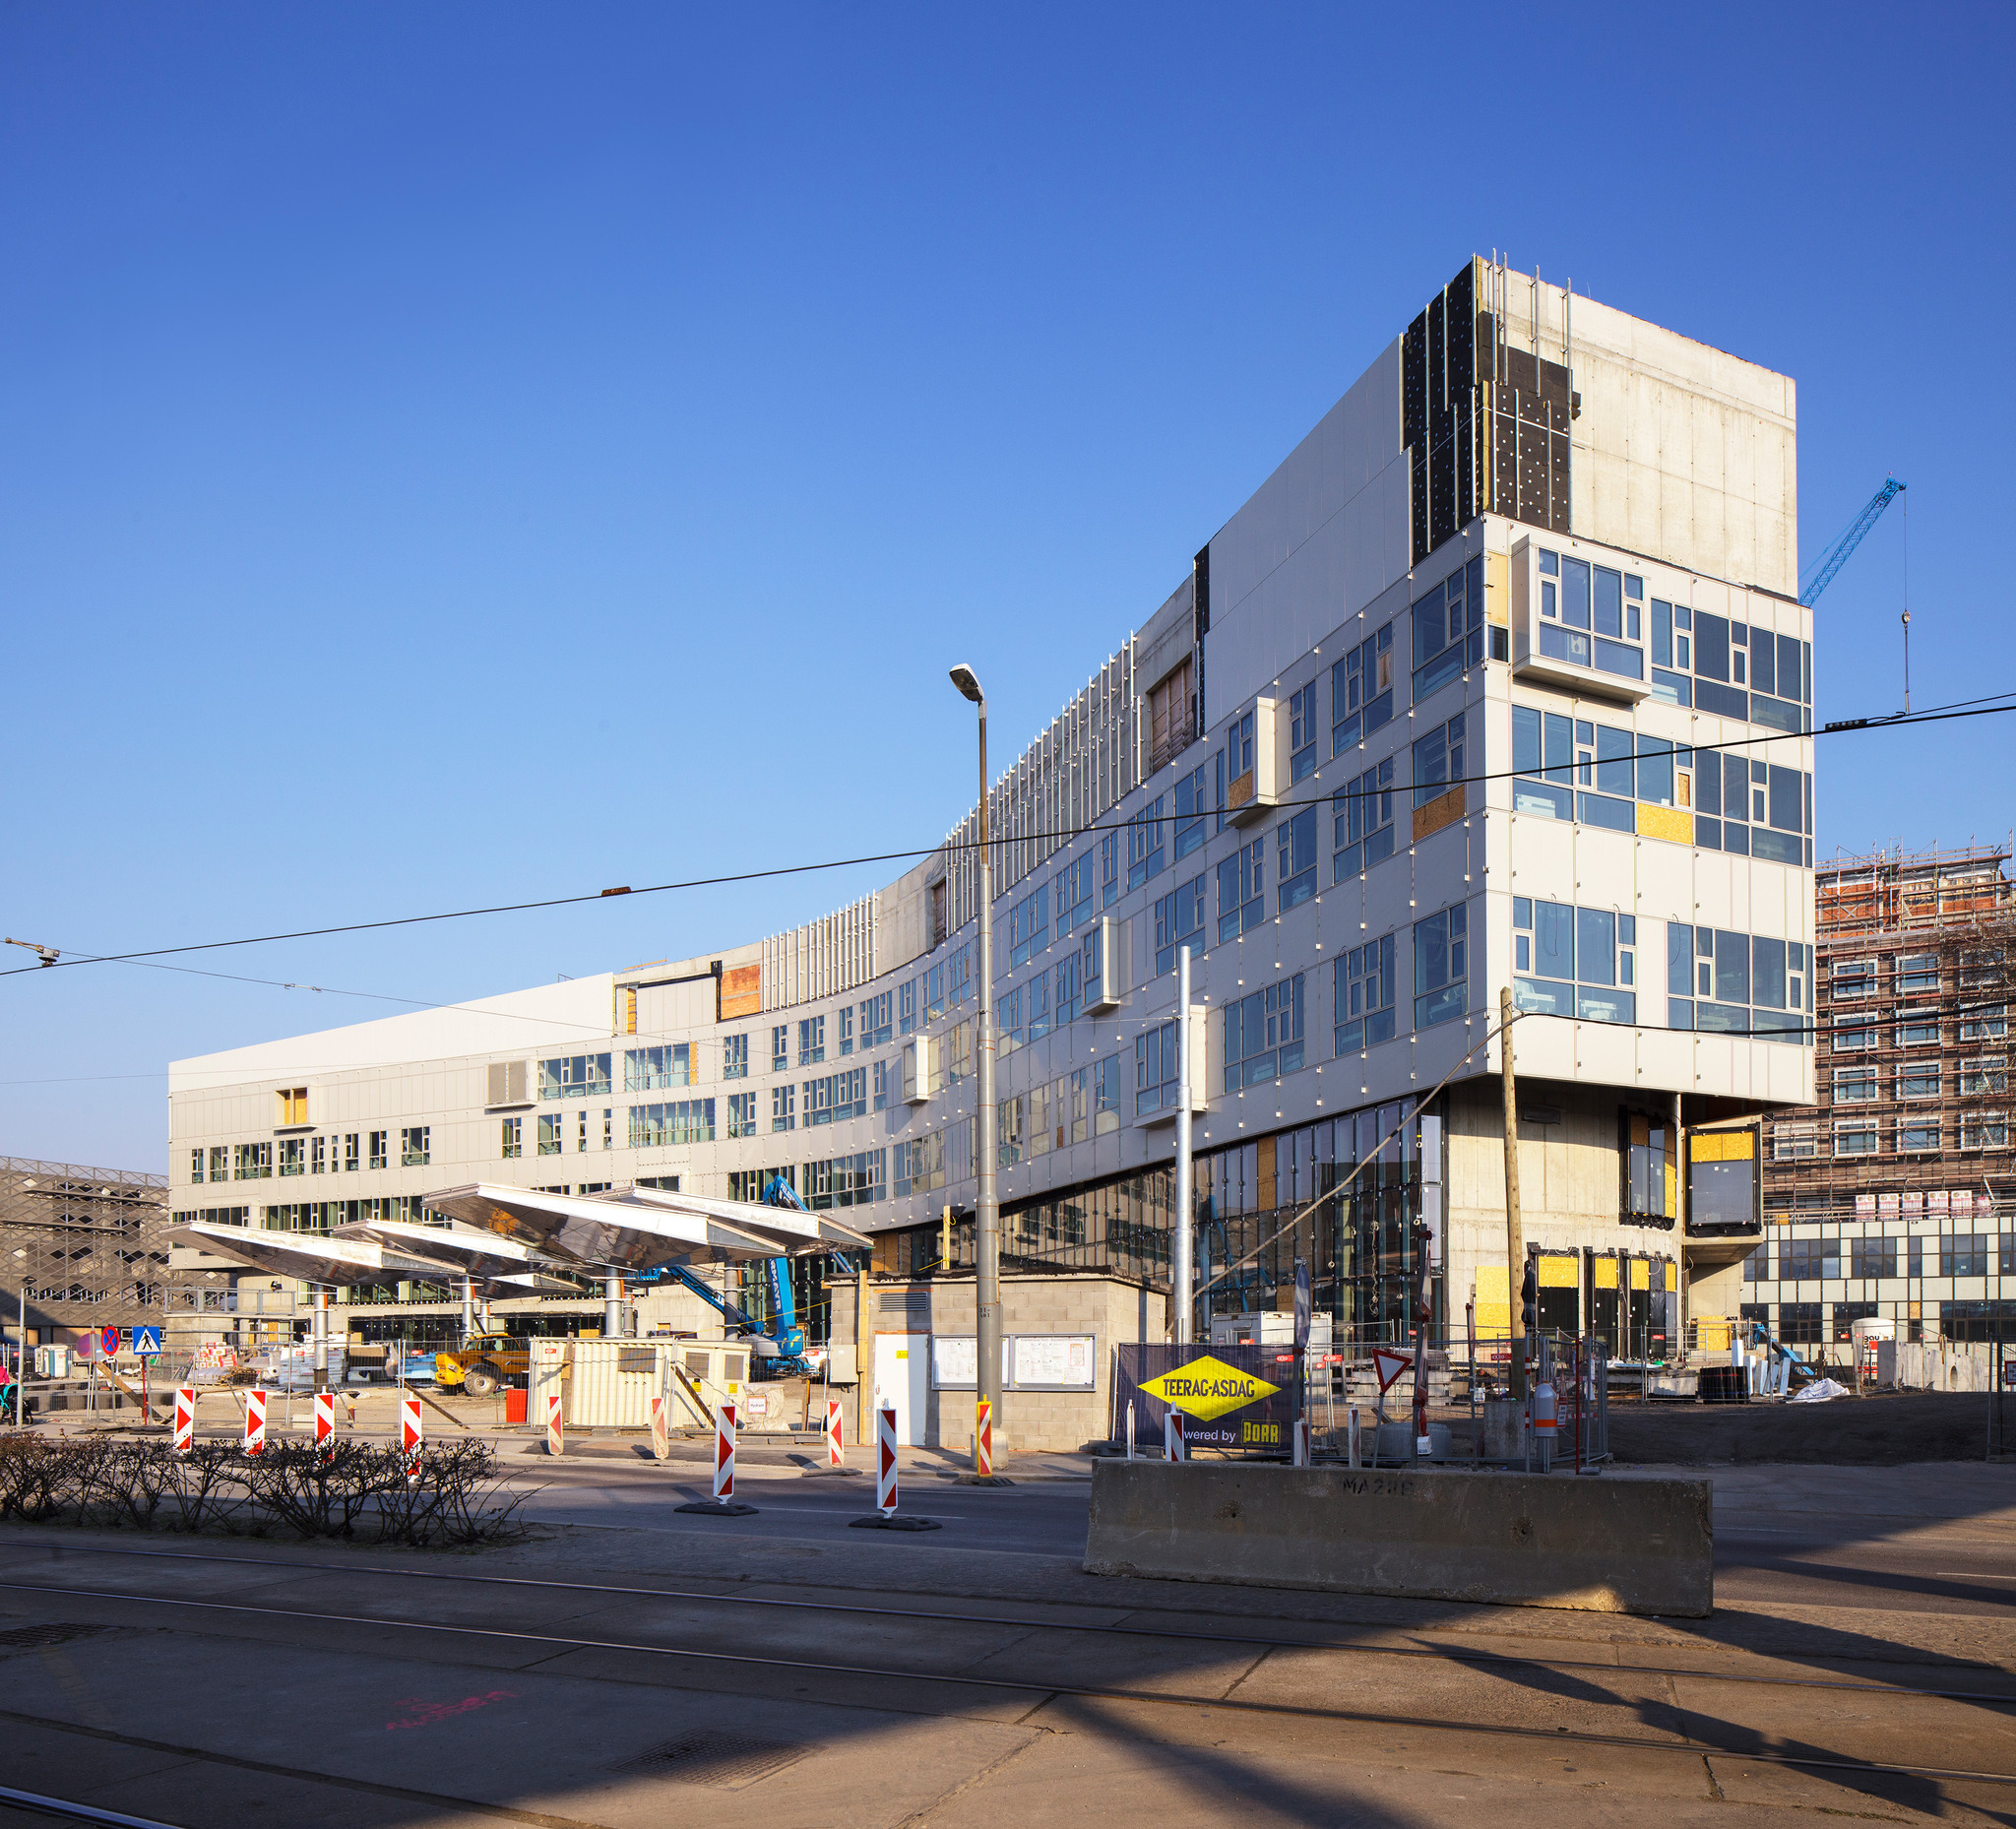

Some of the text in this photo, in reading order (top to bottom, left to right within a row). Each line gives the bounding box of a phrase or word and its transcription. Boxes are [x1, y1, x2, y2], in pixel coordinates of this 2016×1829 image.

[770, 1258, 782, 1310] RMAYR
[1163, 1378, 1255, 1398] TEERAG-ASDAG
[1183, 1421, 1279, 1444] wered by PORR
